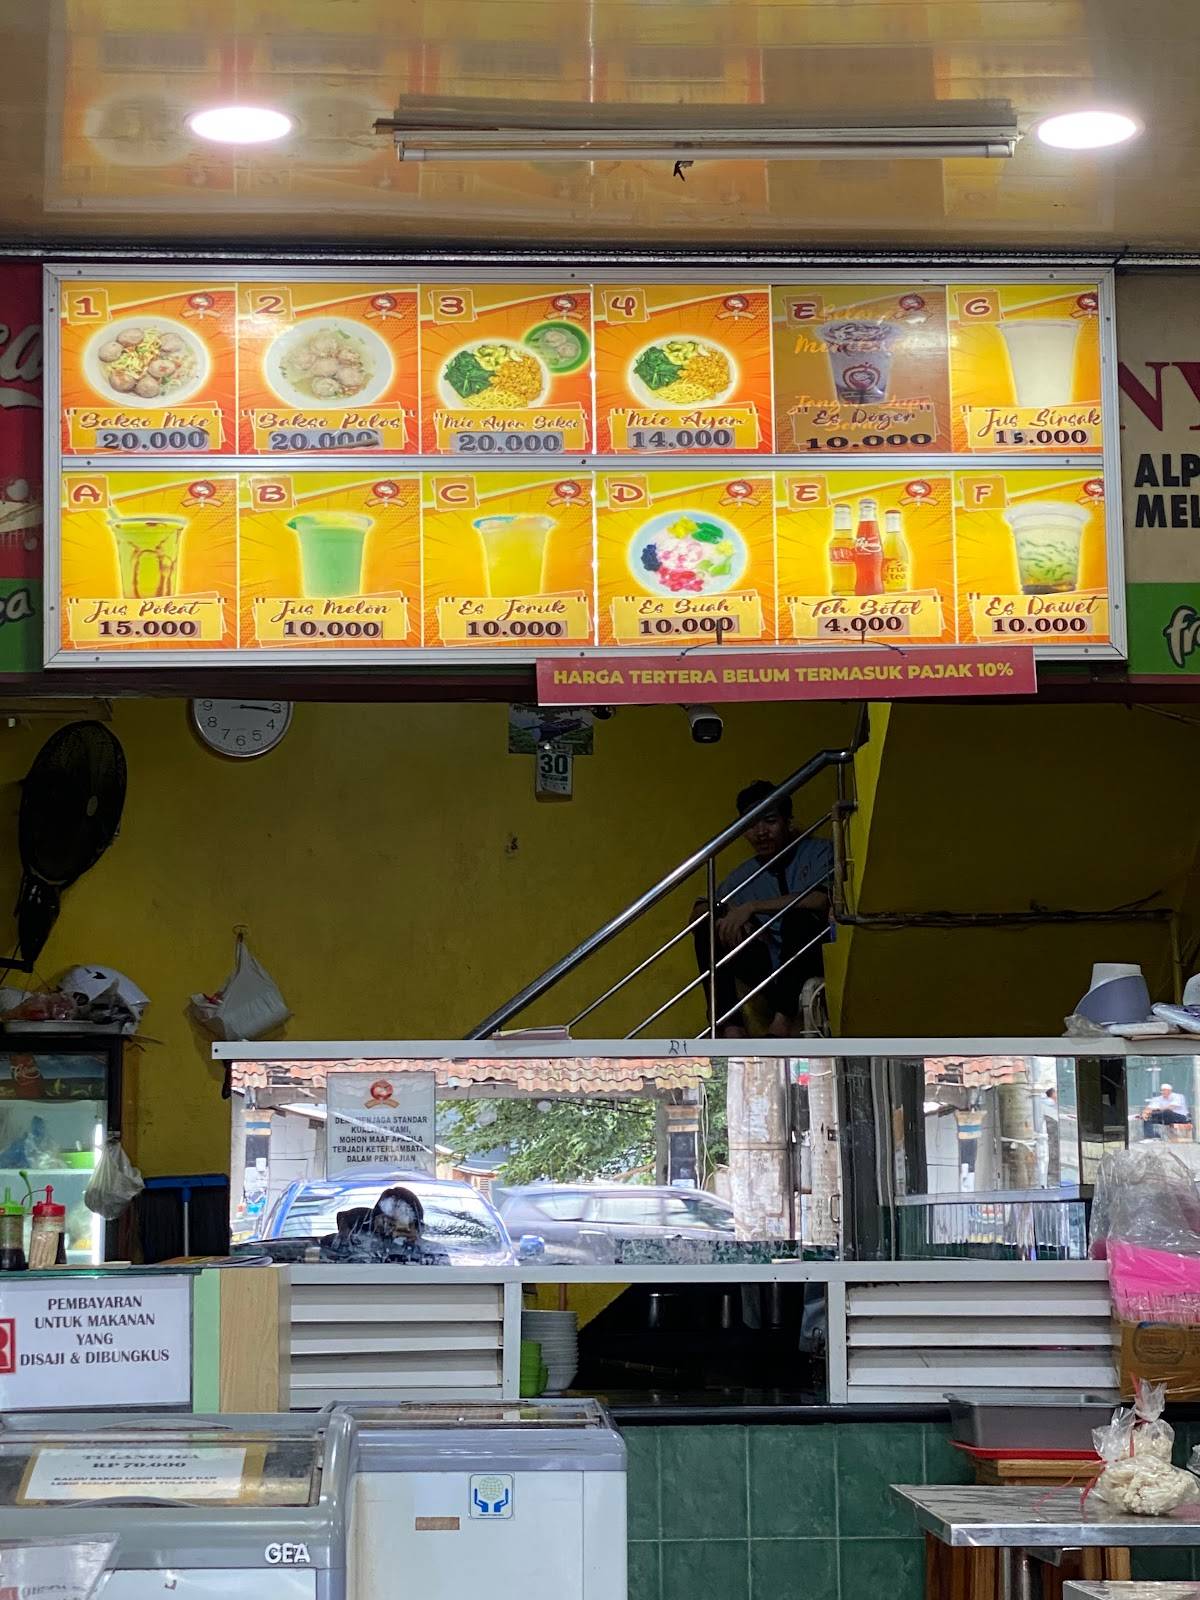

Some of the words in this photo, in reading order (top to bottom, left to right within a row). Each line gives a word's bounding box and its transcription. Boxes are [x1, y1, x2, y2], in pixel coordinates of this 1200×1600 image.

[75, 297, 98, 316] 1
[255, 296, 285, 315] 2
[440, 296, 464, 315] 3
[612, 296, 634, 316] 4
[791, 303, 816, 320] E
[964, 298, 991, 315] G
[103, 431, 206, 449] 20.000
[459, 434, 560, 451] 20.000
[633, 430, 731, 448] 14.000
[806, 433, 932, 449] 10.000
[995, 429, 1087, 444] 15.000
[73, 485, 100, 503] A
[259, 485, 285, 502] B
[441, 484, 467, 502] C
[612, 484, 643, 503] D
[794, 485, 819, 502] E
[976, 485, 992, 502] F
[100, 621, 196, 635] 15.000
[284, 621, 380, 636] 10.000
[468, 621, 562, 636] 10.000
[824, 616, 902, 632] 4.000
[993, 618, 1087, 632] 10.000
[553, 668, 624, 685] HARGA
[629, 668, 718, 685] TERTERA
[723, 667, 790, 683] BELUM
[795, 665, 903, 682] TERMASUK
[908, 663, 973, 679] PAJAK
[977, 662, 1014, 677] 10%
[202, 700, 213, 711] 9
[271, 703, 281, 714] 3
[207, 716, 217, 728] 8
[266, 719, 275, 729] 4
[221, 728, 231, 739] 7
[236, 735, 246, 746] 6
[252, 730, 262, 741] 5
[540, 754, 568, 775] 30
[393, 1116, 428, 1124] STANDAR
[48, 1295, 143, 1311] PEMBAYARAN
[34, 1316, 82, 1329] UNTUK
[87, 1313, 156, 1327] MAKANAN
[76, 1333, 114, 1346] YANG
[20, 1352, 65, 1367] DISAJI
[70, 1352, 81, 1365] &
[86, 1349, 170, 1364] DIBUNGKUS
[264, 1542, 311, 1564] GEA
